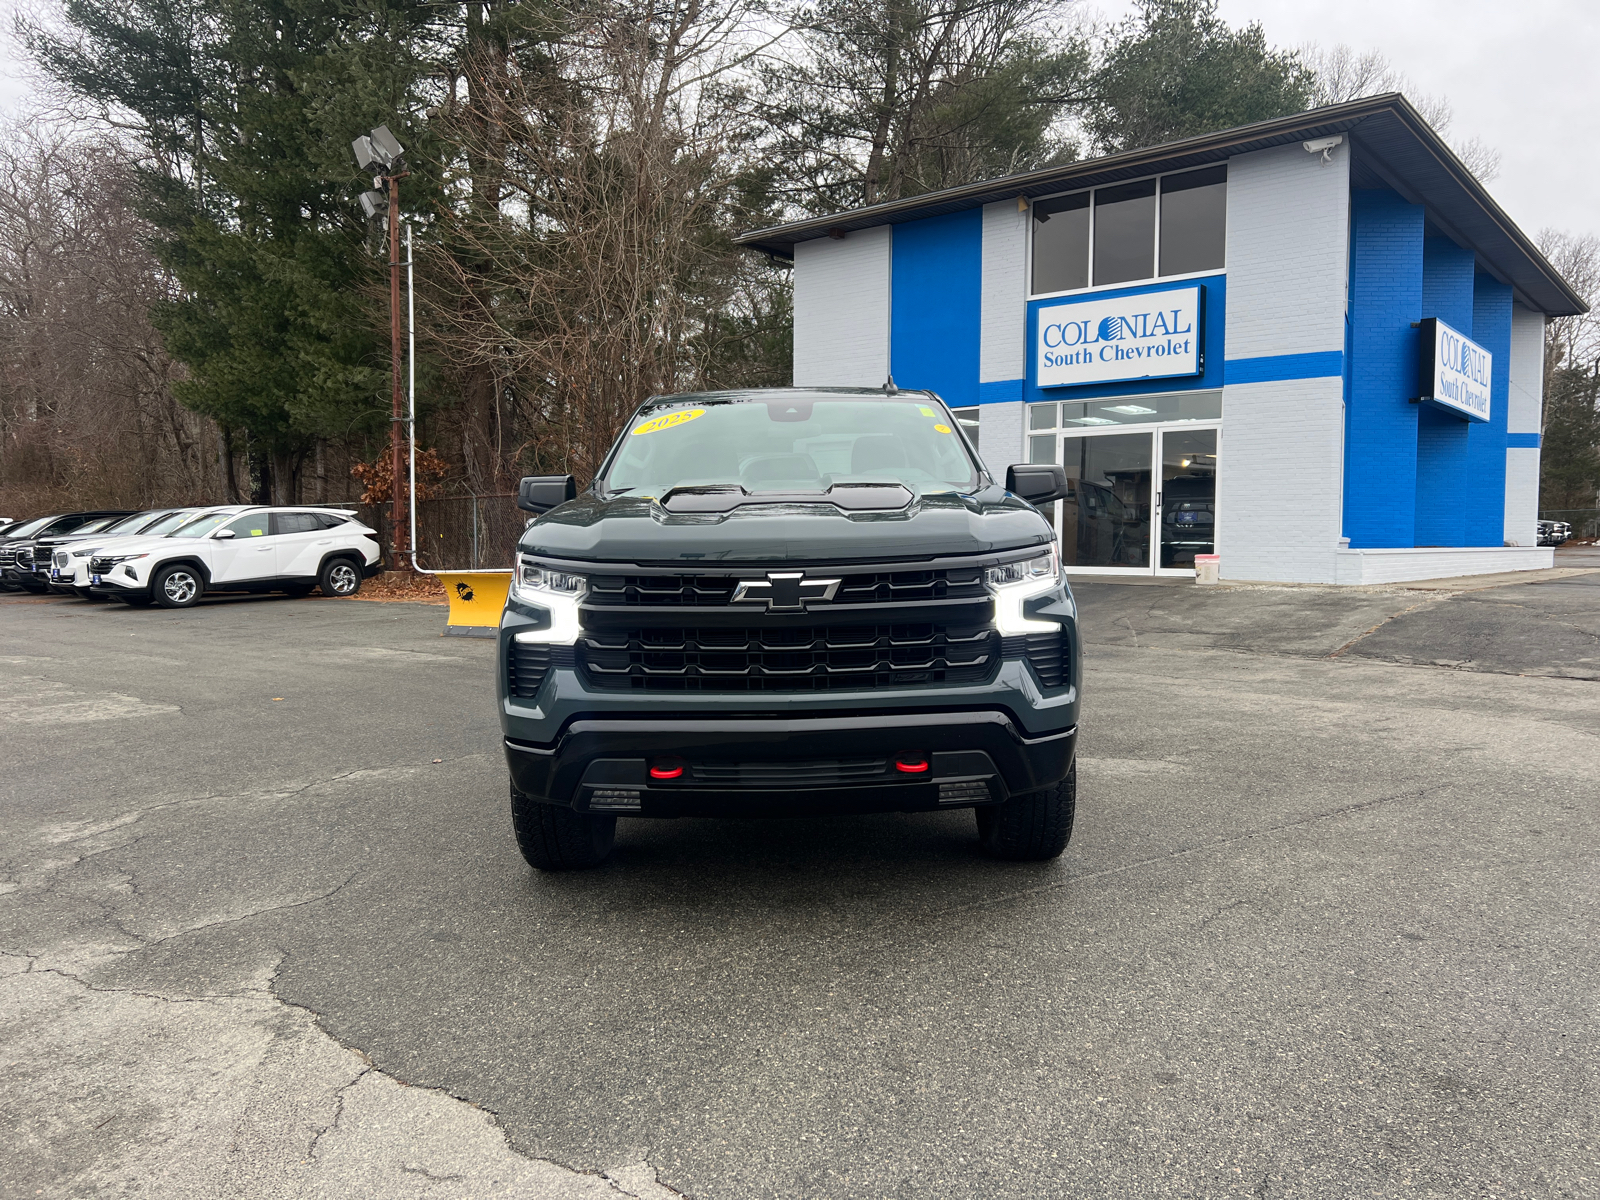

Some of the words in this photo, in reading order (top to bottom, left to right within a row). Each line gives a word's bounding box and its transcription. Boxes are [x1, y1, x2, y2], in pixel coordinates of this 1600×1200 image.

[1043, 309, 1192, 348] COLONIAL
[1043, 348, 1093, 368] South
[1099, 338, 1191, 362] Chevrolet
[1441, 331, 1488, 388] COLONIAL
[1440, 371, 1459, 401] South
[1461, 381, 1487, 413] Chevrolet
[645, 410, 694, 432] 2025
